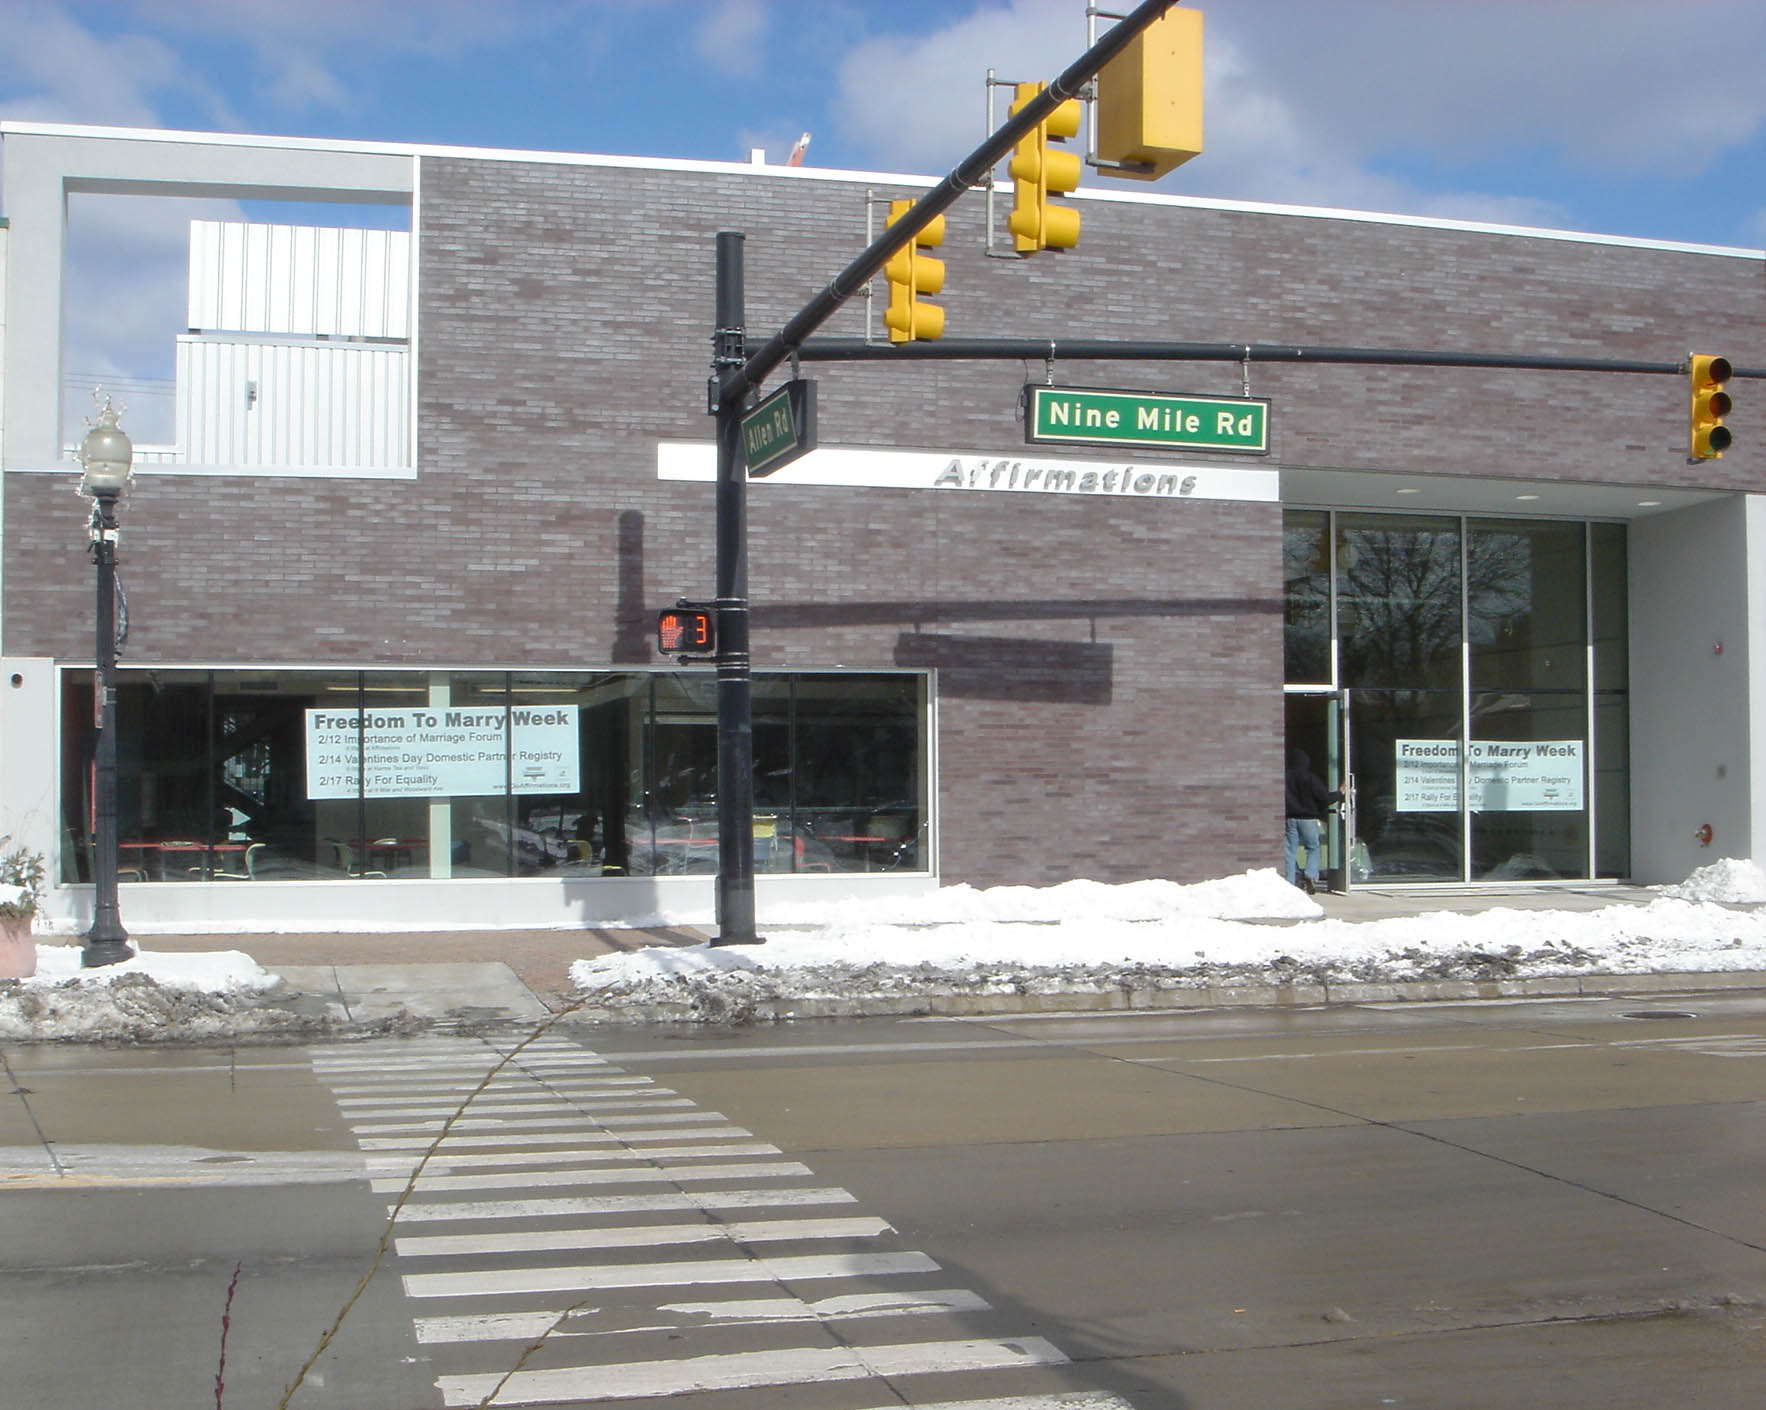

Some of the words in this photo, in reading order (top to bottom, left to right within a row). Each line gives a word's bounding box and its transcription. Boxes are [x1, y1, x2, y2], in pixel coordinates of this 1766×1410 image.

[1051, 402, 1120, 428] Nine
[1137, 407, 1200, 433] Mile
[1216, 411, 1253, 437] Rd
[748, 423, 774, 454] Allen
[773, 407, 789, 438] Rd
[933, 458, 1198, 496] Affirmations
[695, 616, 707, 643] 3
[314, 713, 405, 729] Freedom
[412, 713, 438, 728] To
[445, 711, 507, 730] Marry
[511, 710, 569, 726] Week
[318, 734, 341, 744] 2/12
[345, 734, 403, 744] Imortance
[406, 733, 416, 743] of
[420, 732, 465, 744] Marriage
[469, 732, 502, 742] Forum
[319, 754, 341, 764] 2/14
[402, 753, 423, 764] Day
[426, 752, 475, 762] Domestic
[478, 751, 516, 761] Partnr
[520, 751, 562, 762] Registry
[1402, 744, 1460, 757] Freedom
[1488, 745, 1531, 760] Marry
[1536, 744, 1576, 757] Week
[1504, 760, 1529, 769] Forum
[319, 776, 342, 785] 2/17
[345, 775, 371, 787] Ray
[375, 775, 393, 784] For
[396, 774, 437, 785] Equality
[1404, 776, 1419, 784] 2/14
[1511, 776, 1539, 784] Partner
[1404, 793, 1419, 801] 2/17
